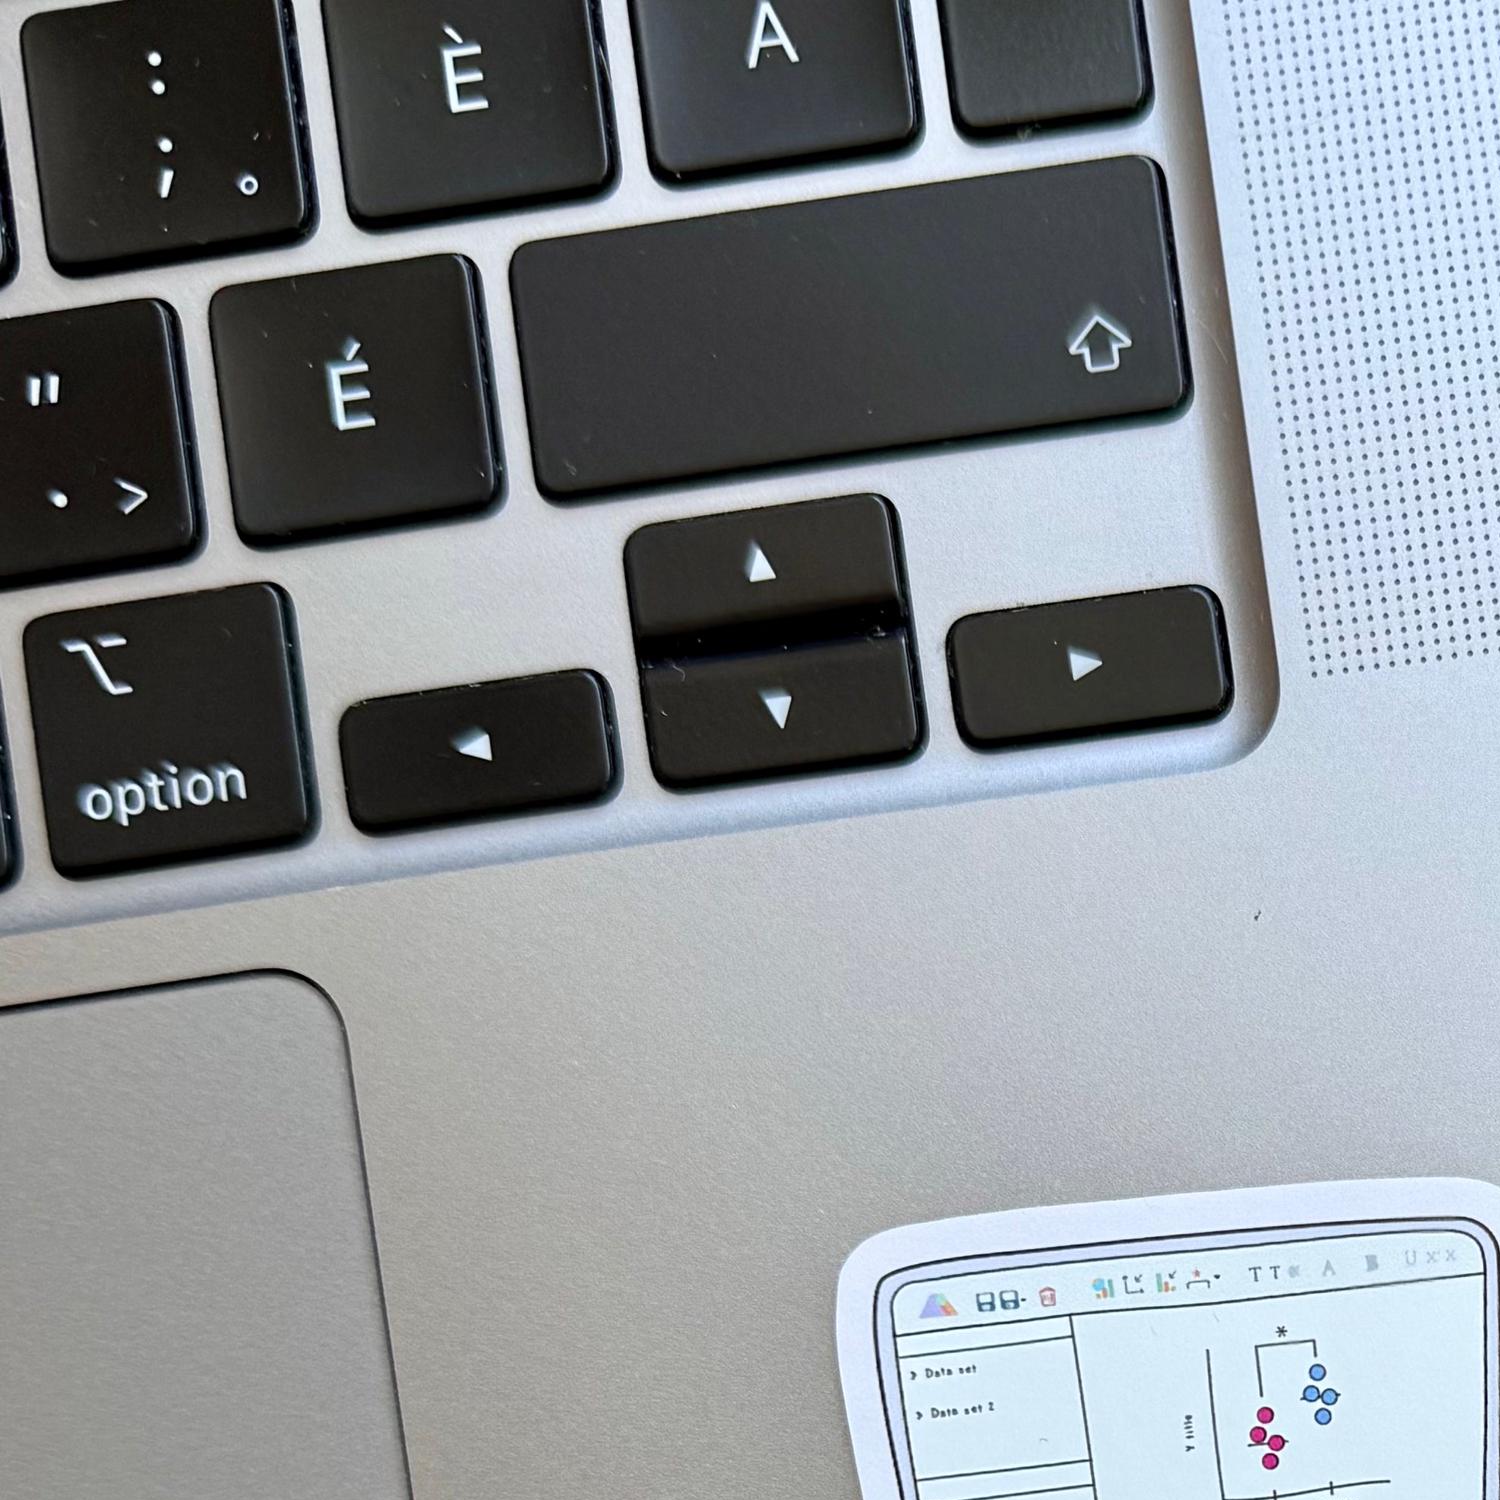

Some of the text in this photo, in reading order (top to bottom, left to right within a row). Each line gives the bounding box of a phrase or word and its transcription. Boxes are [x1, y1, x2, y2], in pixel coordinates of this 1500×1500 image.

[441, 23, 489, 115] È
[326, 337, 377, 431] É
[78, 761, 249, 828] option
[925, 1364, 977, 1379] Data set
[930, 1407, 959, 1419] Data
[964, 1404, 983, 1415] set
